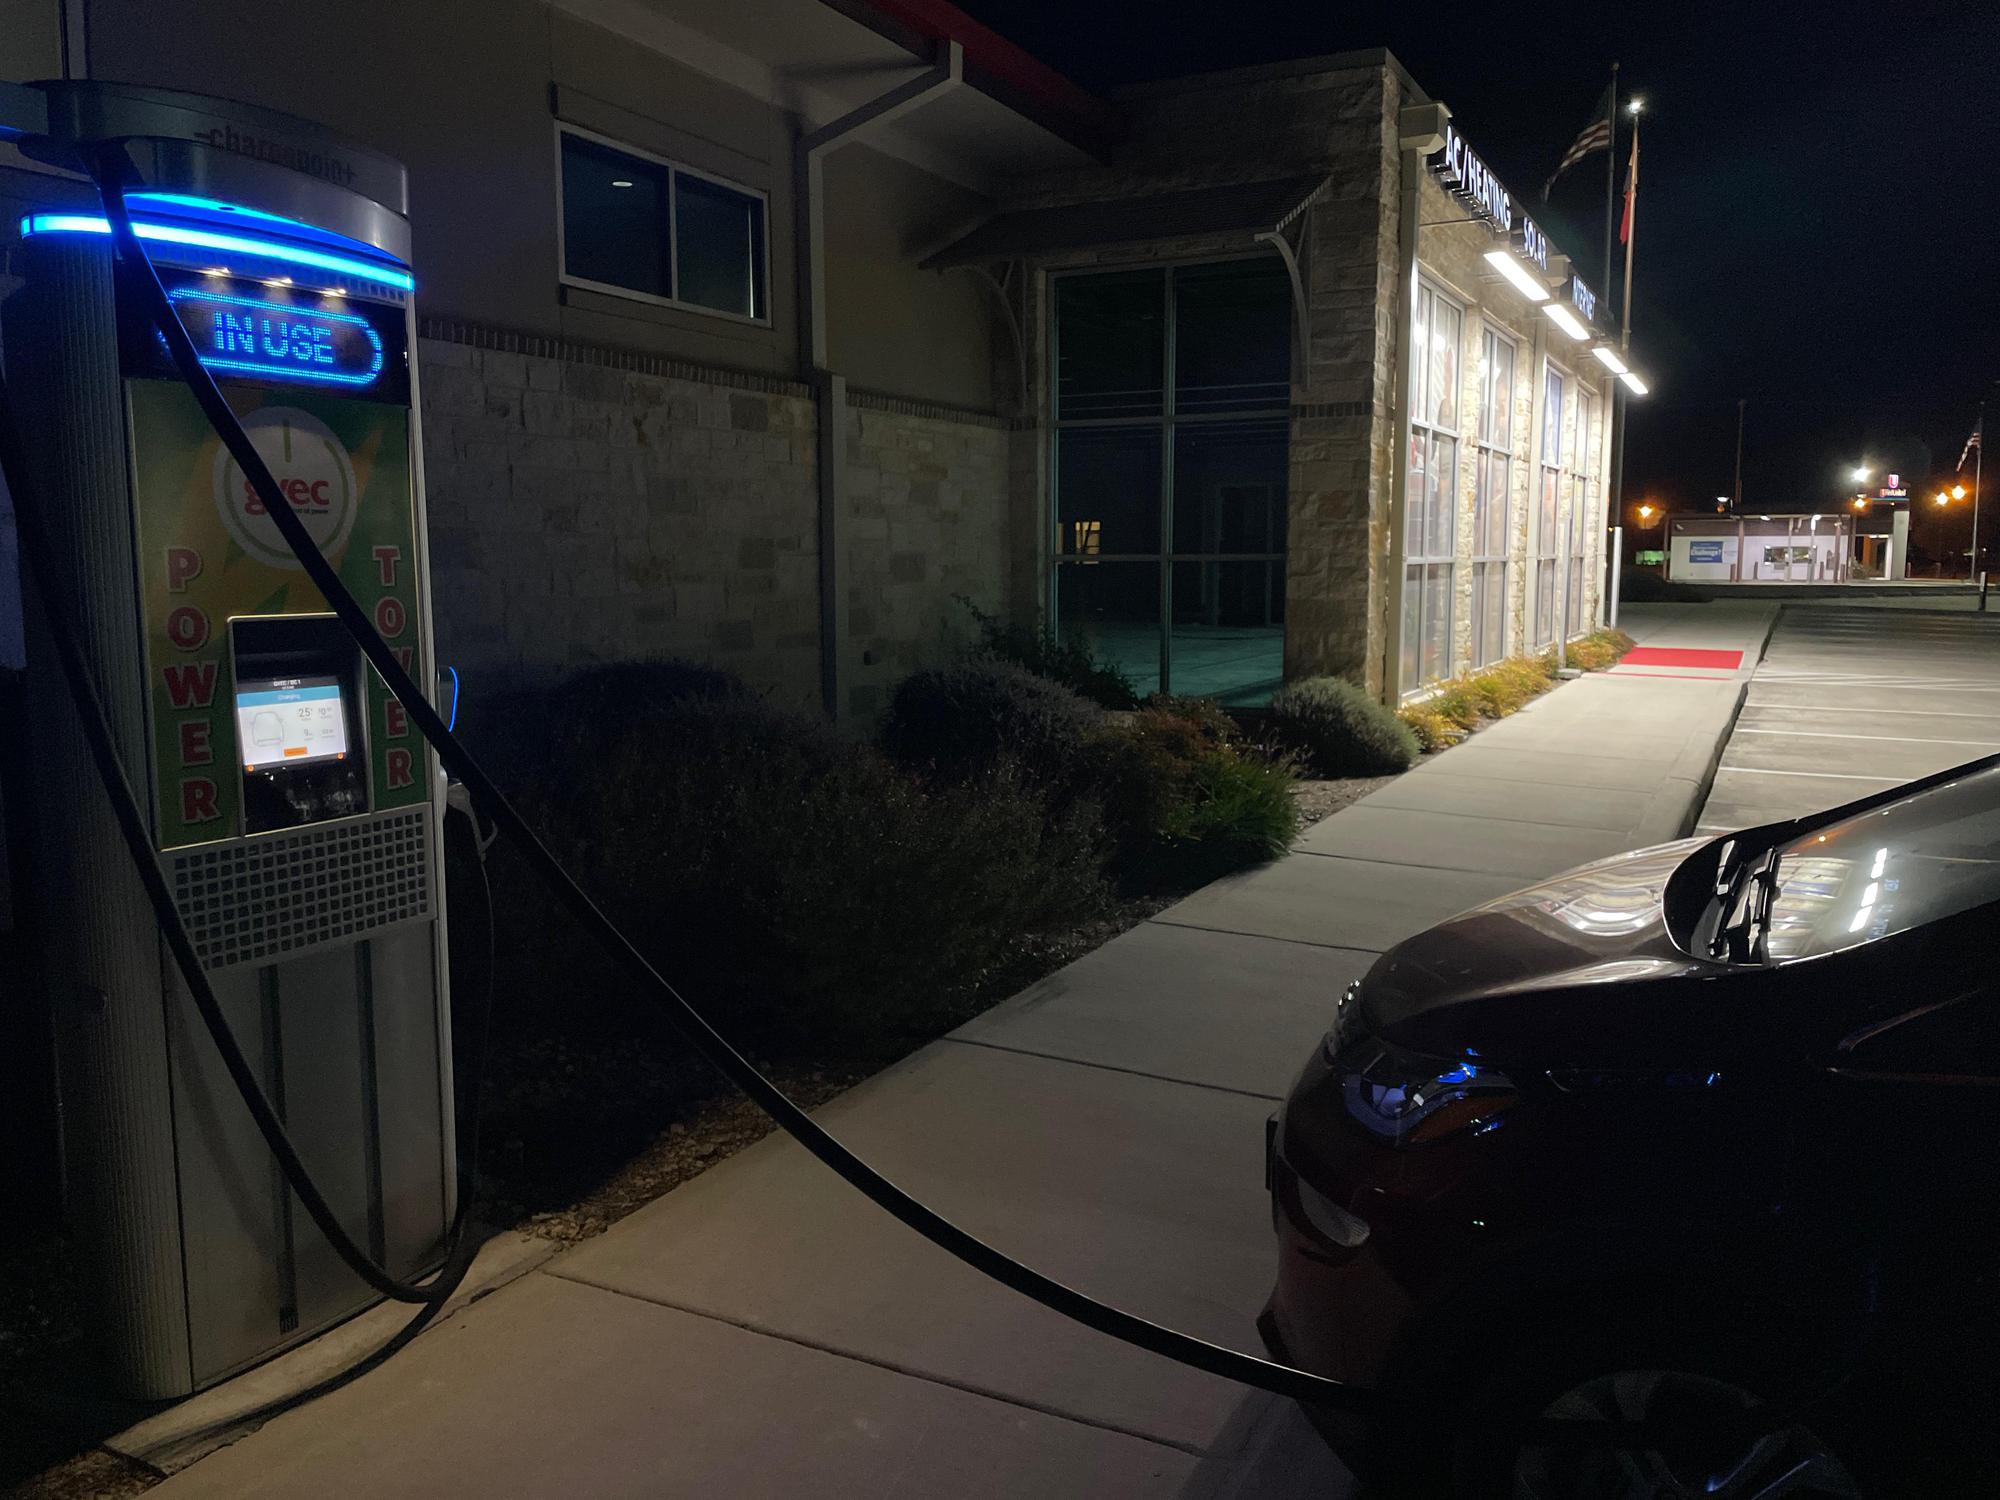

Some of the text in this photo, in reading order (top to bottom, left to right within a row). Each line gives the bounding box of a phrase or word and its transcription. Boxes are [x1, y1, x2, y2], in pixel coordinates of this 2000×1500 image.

[1523, 216, 1547, 271] SOLAR
[214, 310, 335, 364] IN USE
[244, 478, 330, 515] gec
[162, 547, 223, 825] POWER
